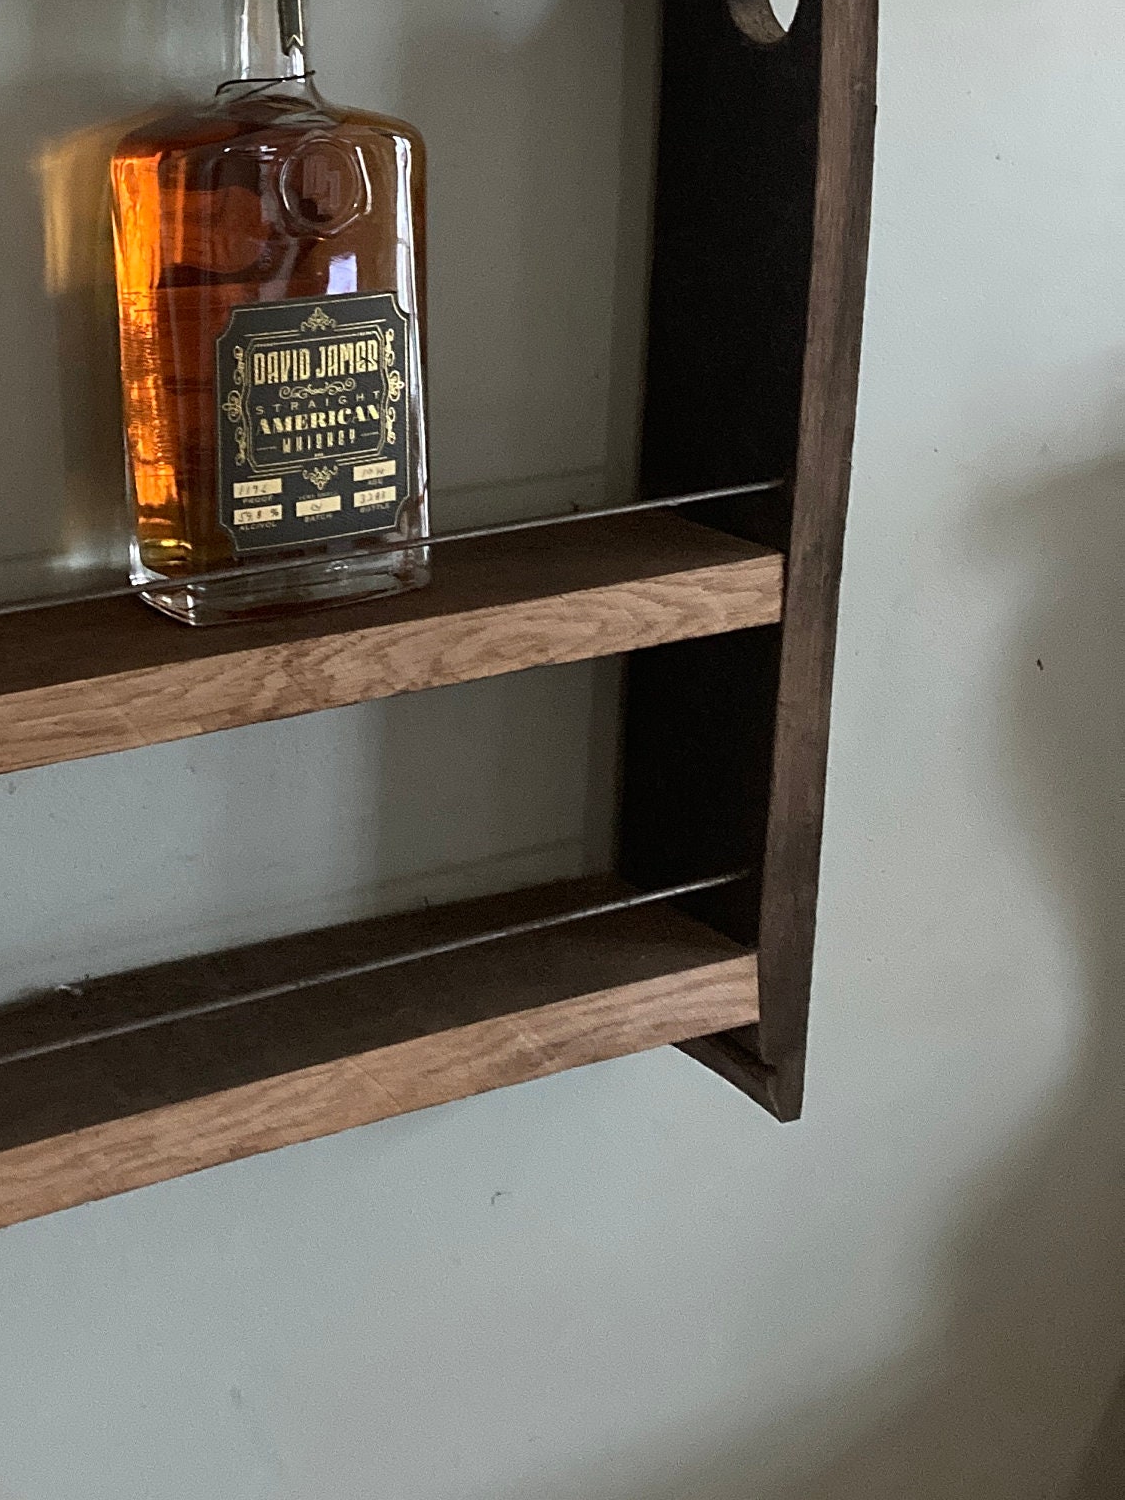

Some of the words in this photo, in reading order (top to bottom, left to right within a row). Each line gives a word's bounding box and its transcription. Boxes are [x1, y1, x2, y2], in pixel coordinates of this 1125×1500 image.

[253, 347, 311, 386] DAVID
[315, 339, 379, 379] JAMES
[255, 390, 381, 415] STRAIGHT
[255, 404, 380, 436] AMERICAN
[282, 428, 356, 454] WHISKEY
